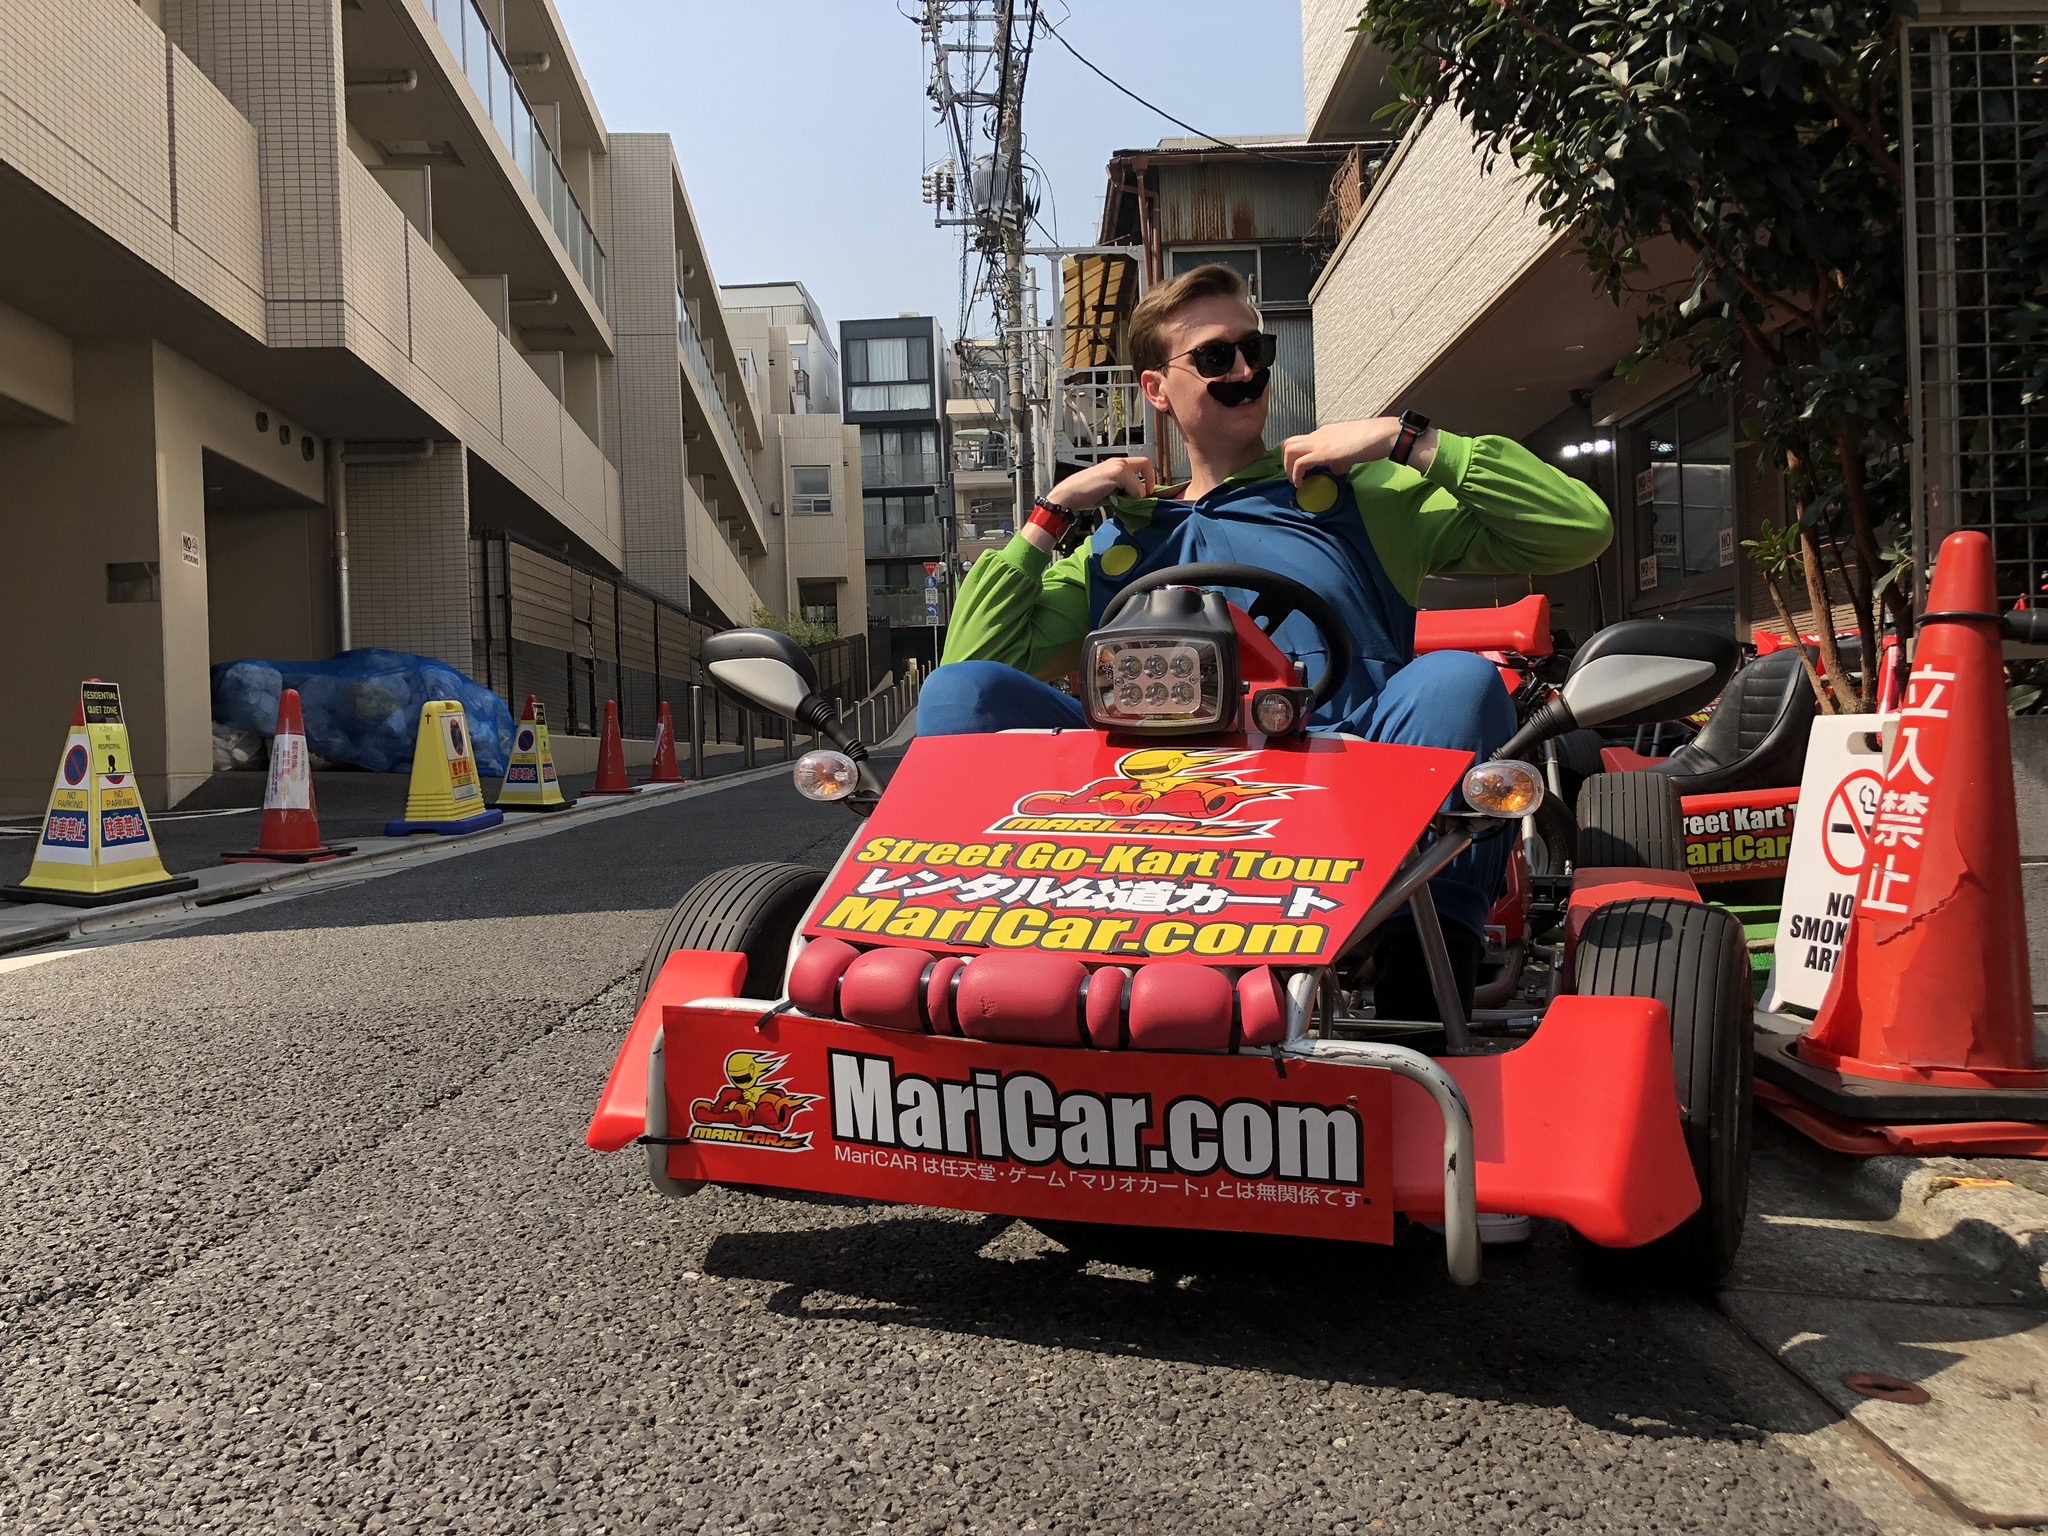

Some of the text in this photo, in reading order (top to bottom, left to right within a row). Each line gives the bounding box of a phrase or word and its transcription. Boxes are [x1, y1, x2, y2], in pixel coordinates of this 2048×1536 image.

[183, 535, 191, 550] NO
[1721, 533, 1731, 548] NO
[183, 553, 198, 565] SMOKING
[1640, 561, 1648, 575] NO
[83, 690, 118, 700] RESIDENTIAL
[87, 705, 118, 714] QUIET ZONE
[67, 791, 76, 799] NO
[114, 790, 123, 798] NO
[1861, 663, 1957, 915] 立入禁止
[58, 800, 83, 809] PARKING
[106, 798, 133, 808] PARKING
[104, 814, 145, 841] 駐車禁止
[1001, 818, 1203, 836] MARICAR
[1733, 806, 1786, 831] Kart
[48, 816, 86, 841] 駐車禁止
[857, 836, 1361, 883] Street Go-Kart Tour
[1686, 835, 1791, 866] ariCar
[857, 868, 1342, 918] レンタル公道カート
[1826, 892, 1855, 919] NO
[821, 897, 1325, 957] MariCar.com
[830, 1050, 1361, 1185] MariCar.com
[693, 1127, 784, 1146] MARICAR
[834, 1145, 917, 1171] MariCAR
